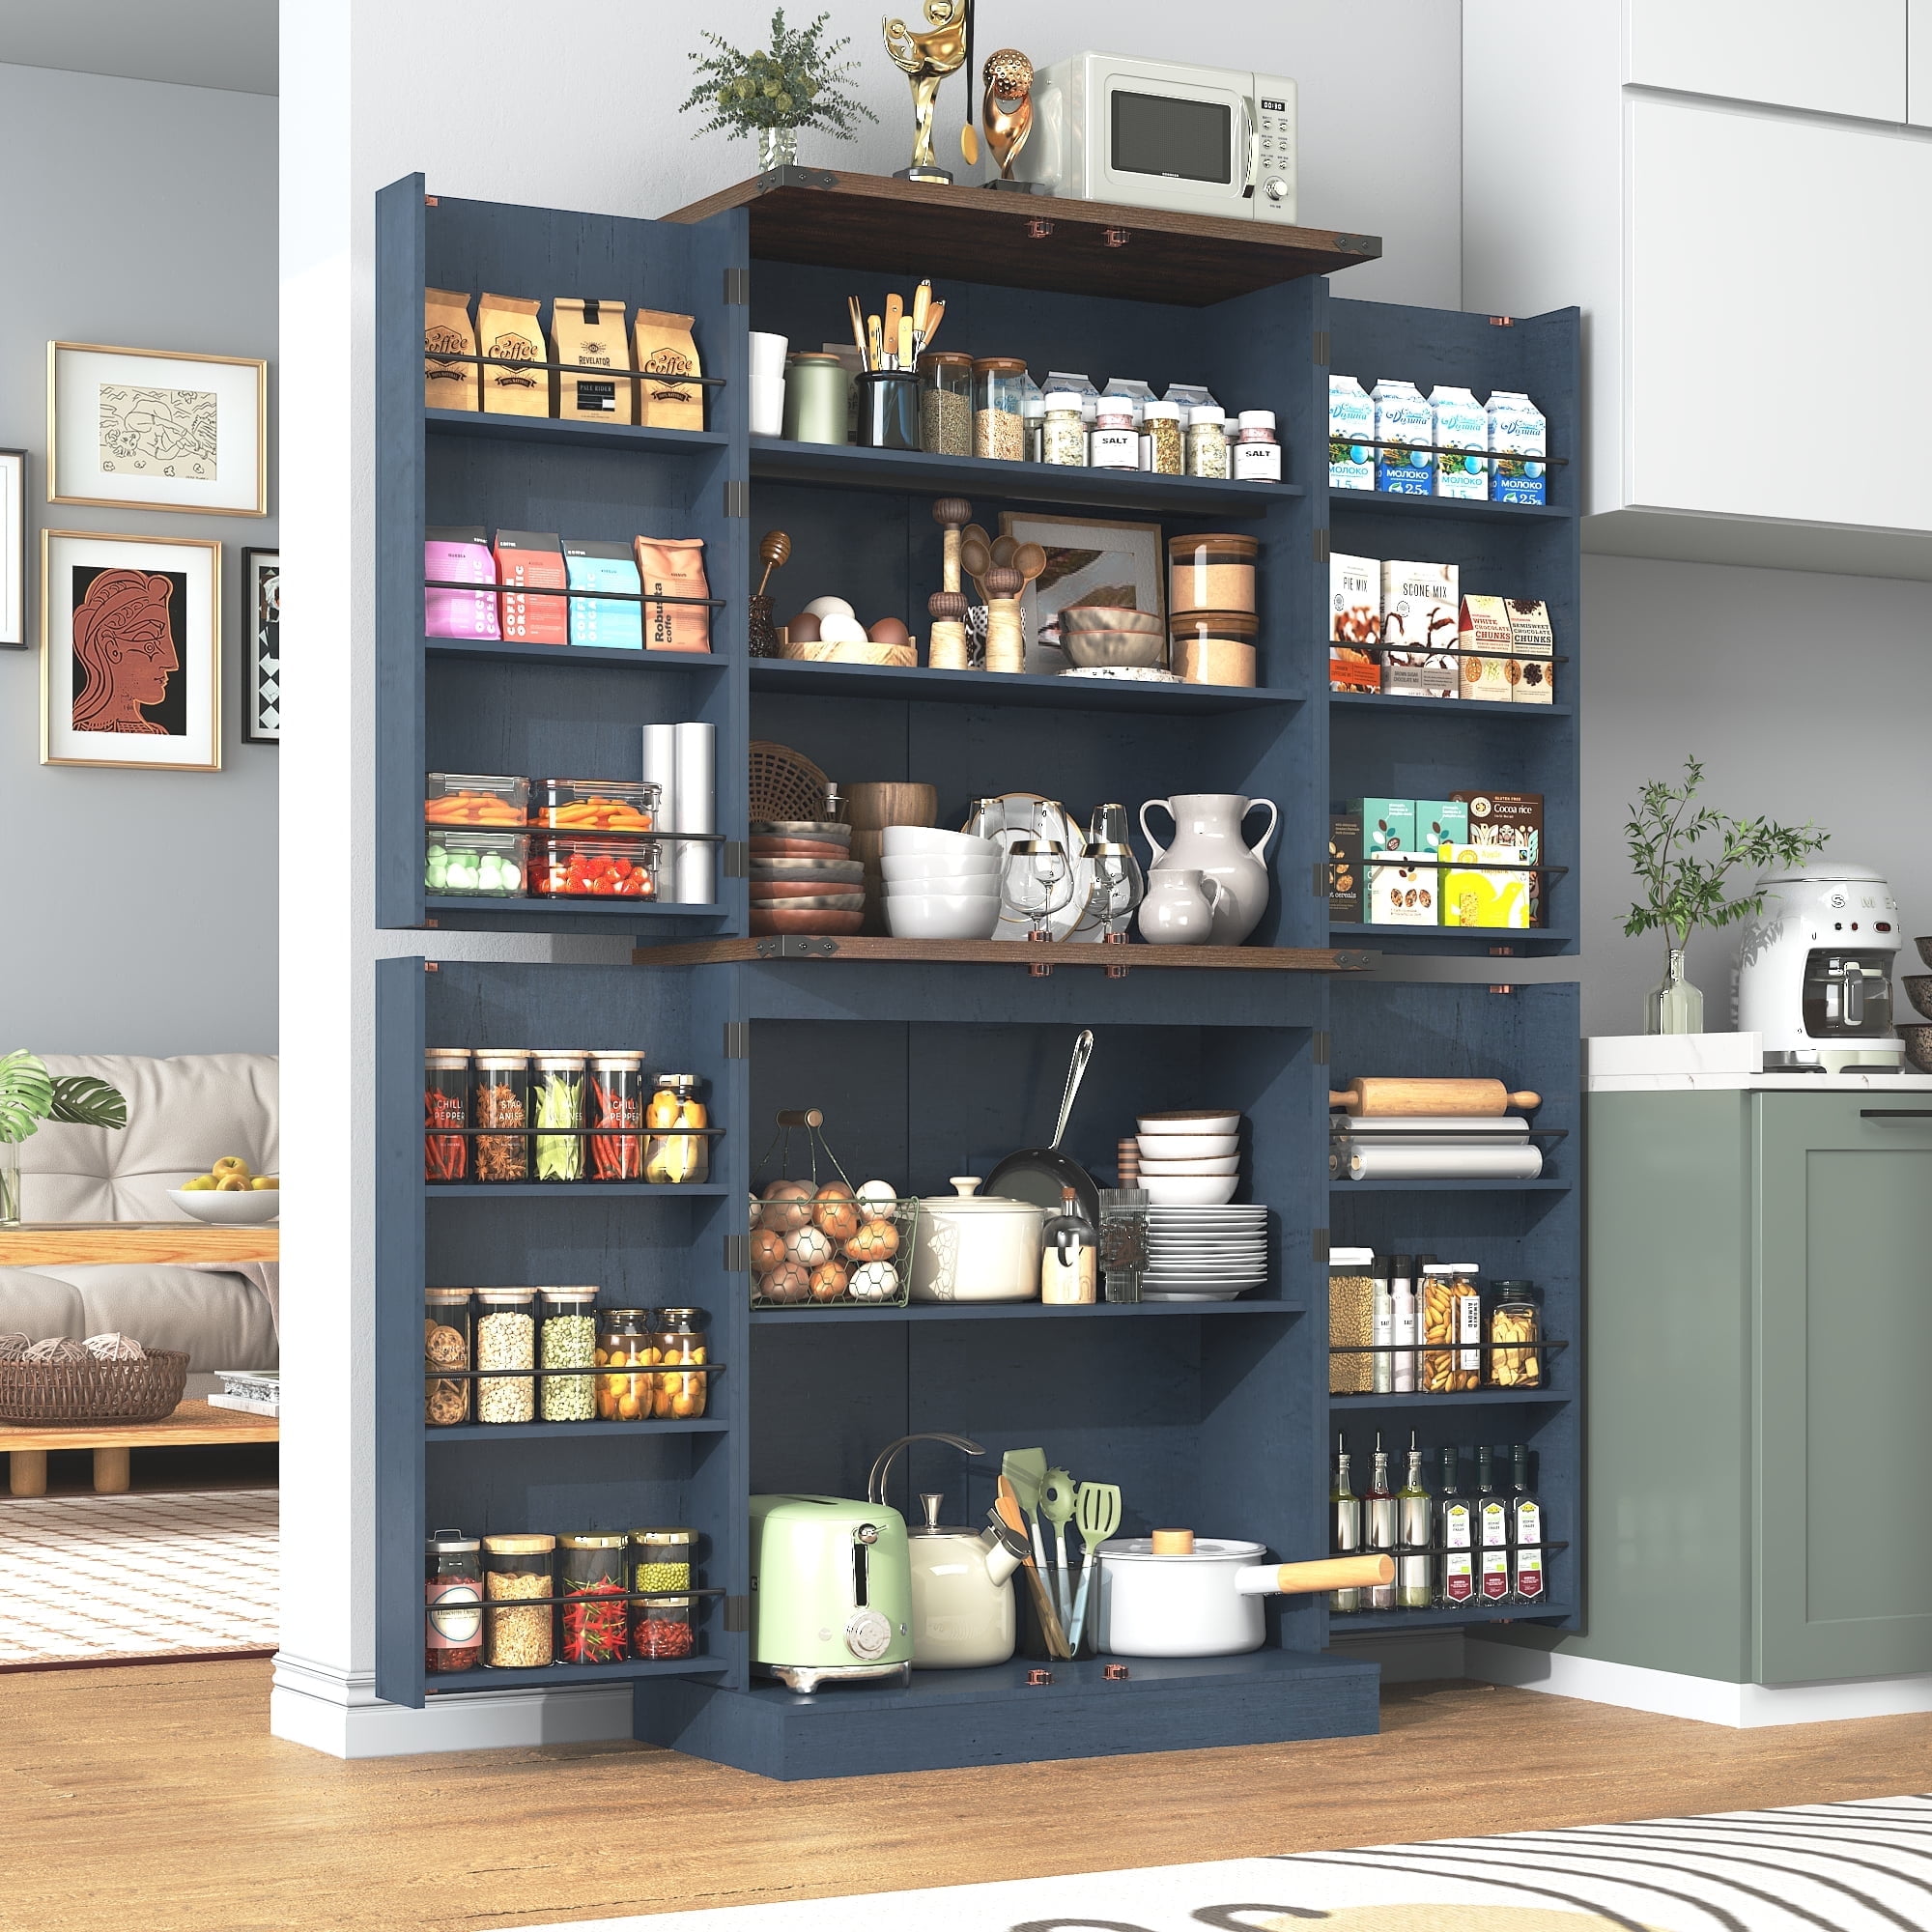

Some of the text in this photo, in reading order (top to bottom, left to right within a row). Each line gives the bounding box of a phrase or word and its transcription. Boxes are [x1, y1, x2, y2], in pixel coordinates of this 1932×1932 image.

[579, 355, 611, 367] REVELATOR
[1386, 469, 1429, 479] МОЛОКО
[1441, 476, 1482, 486] МОЛОКО
[1501, 480, 1543, 490] МОЛОКО
[1343, 577, 1368, 592] PIE MIX
[1403, 582, 1447, 598] SCONE MIX
[654, 582, 665, 642] Robuta
[1475, 631, 1511, 639] CHUNKS
[1514, 635, 1551, 643] CHUNKS
[1493, 803, 1532, 813] Cocoa rice
[435, 1112, 465, 1121] PEPPER
